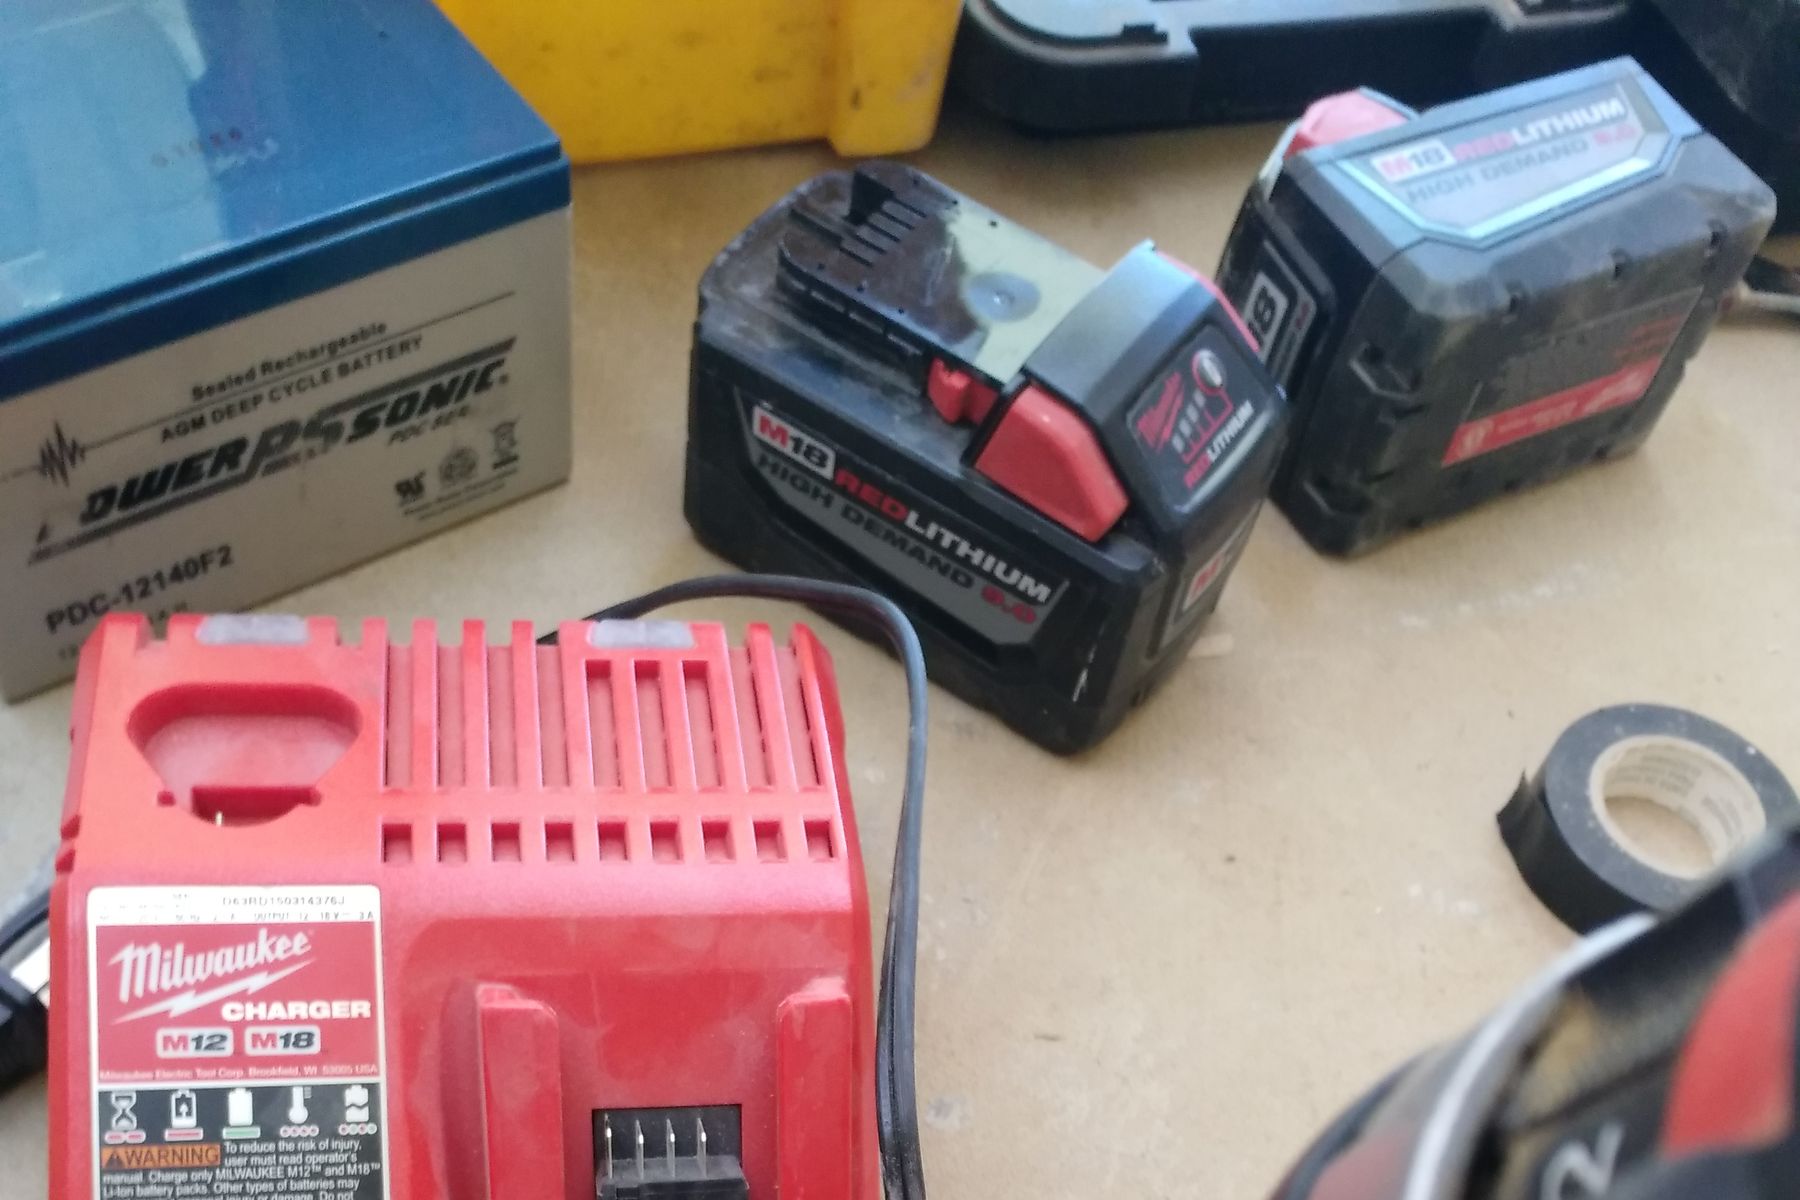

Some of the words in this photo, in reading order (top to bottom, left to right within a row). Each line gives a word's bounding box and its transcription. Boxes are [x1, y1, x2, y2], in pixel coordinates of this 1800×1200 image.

[1380, 145, 1448, 179] M18
[1406, 172, 1477, 202] HIGH
[1479, 137, 1590, 182] DEMAND
[191, 366, 258, 402] Sealed
[259, 322, 388, 376] Rechargeable
[161, 415, 206, 443] AGM
[211, 393, 264, 424] DEEP
[267, 368, 332, 403] CYCLE
[336, 335, 422, 379] BATTERY
[758, 413, 829, 470] M18
[40, 436, 250, 542] OWER
[757, 451, 834, 509] HIGH
[840, 502, 976, 590] DEMAND
[45, 544, 235, 636] PDC-12140F2
[107, 927, 313, 1005] Milwaukee
[221, 999, 372, 1023] CHARGER
[162, 1033, 228, 1053] M12
[251, 1030, 315, 1051] M18
[125, 1146, 219, 1166] WARNING
[225, 1141, 237, 1154] To
[239, 1140, 276, 1153] reduce
[278, 1140, 295, 1152] the
[297, 1139, 317, 1151] risk
[318, 1139, 329, 1151] of
[331, 1138, 362, 1154] injury,
[225, 1155, 247, 1167] user
[250, 1154, 277, 1166] must
[279, 1152, 303, 1165] read
[305, 1151, 358, 1166] operator's
[148, 1170, 188, 1184] Charge
[190, 1169, 213, 1184] only
[215, 1164, 285, 1181] MILWAUKEE
[324, 1163, 345, 1177] and
[212, 1181, 243, 1194] Other
[245, 1179, 275, 1195] types
[277, 1178, 288, 1191] of
[289, 1178, 335, 1192] batteries
[337, 1178, 361, 1192] may
